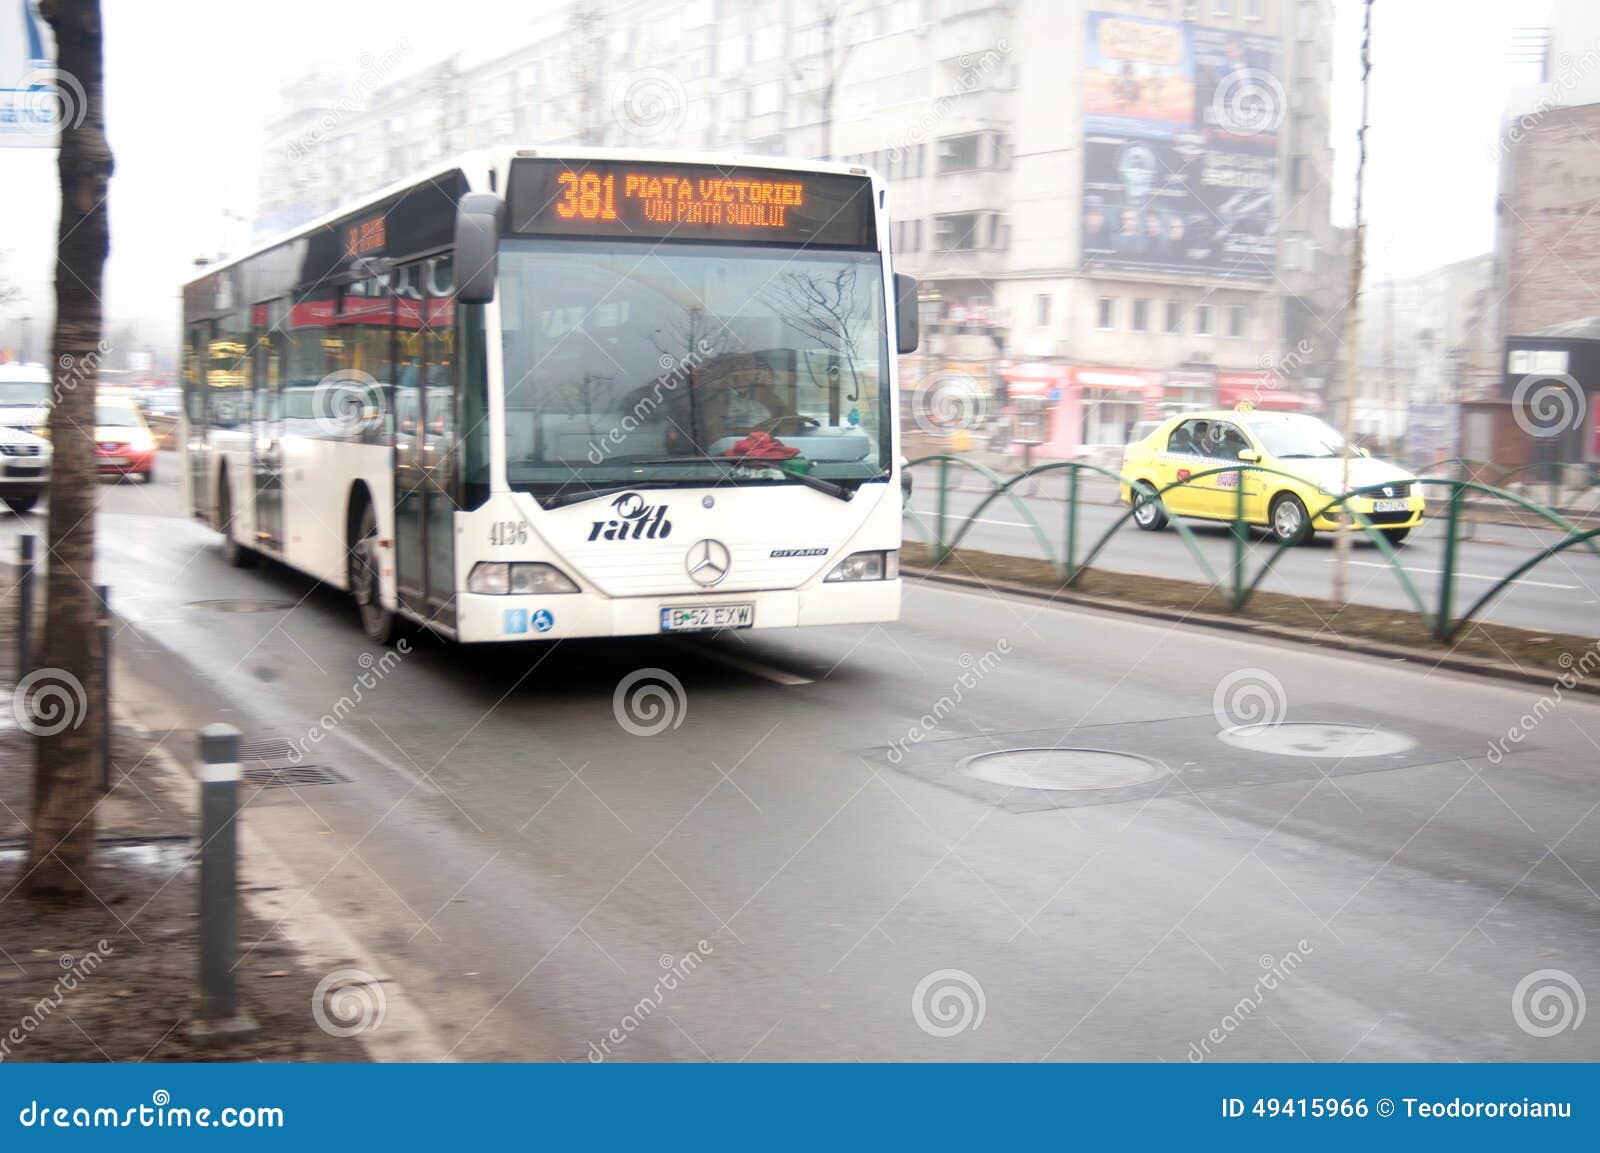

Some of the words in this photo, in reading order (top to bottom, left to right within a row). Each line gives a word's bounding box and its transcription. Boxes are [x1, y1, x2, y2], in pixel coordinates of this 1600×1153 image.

[557, 172, 617, 220] 381
[625, 175, 693, 201] PIATA
[700, 179, 803, 206] VICTORIEI
[645, 199, 672, 222] VIA
[677, 201, 722, 225] PIATA
[489, 521, 528, 546] 4136
[770, 548, 828, 558] CITARO
[673, 610, 684, 626] B
[691, 609, 709, 625] 52
[715, 606, 751, 624] EXW
